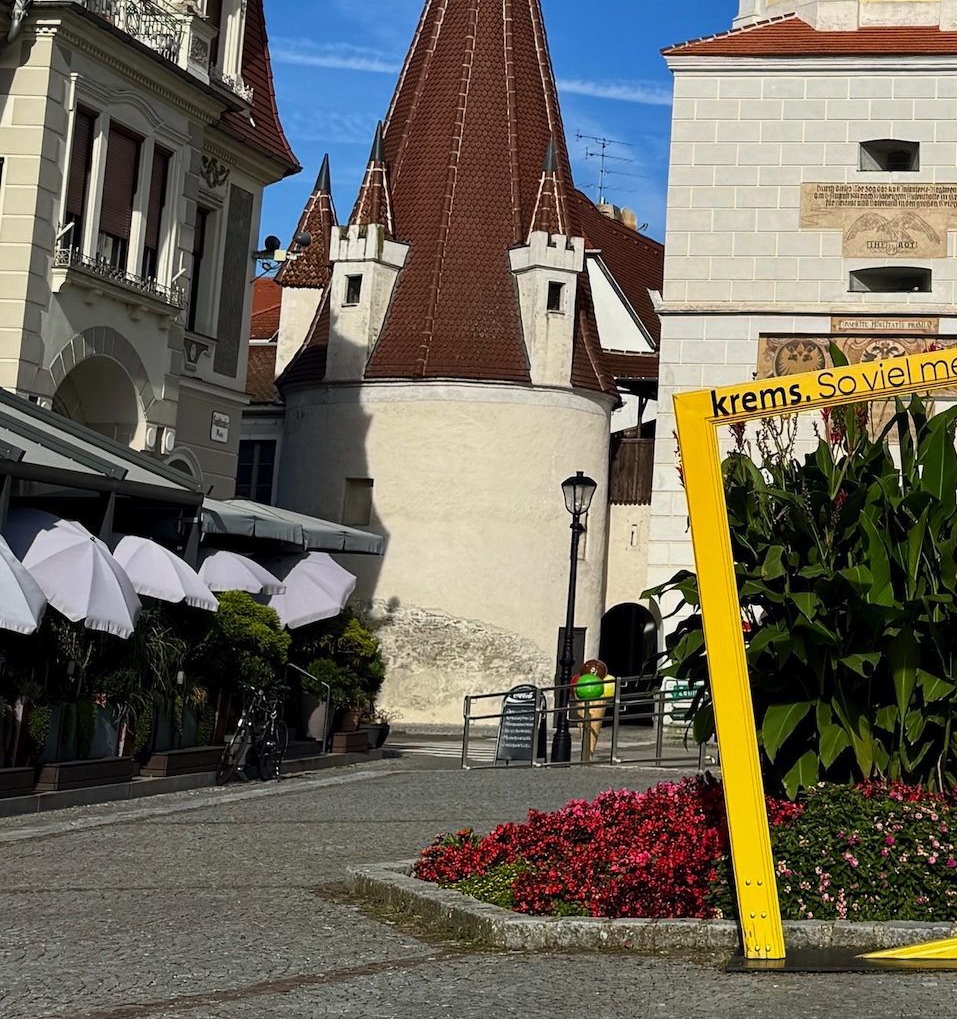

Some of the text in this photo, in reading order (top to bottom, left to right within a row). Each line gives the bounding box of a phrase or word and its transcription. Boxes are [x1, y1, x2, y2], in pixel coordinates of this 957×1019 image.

[711, 382, 811, 417] krems.
[818, 372, 857, 399] So
[862, 359, 912, 391] viel
